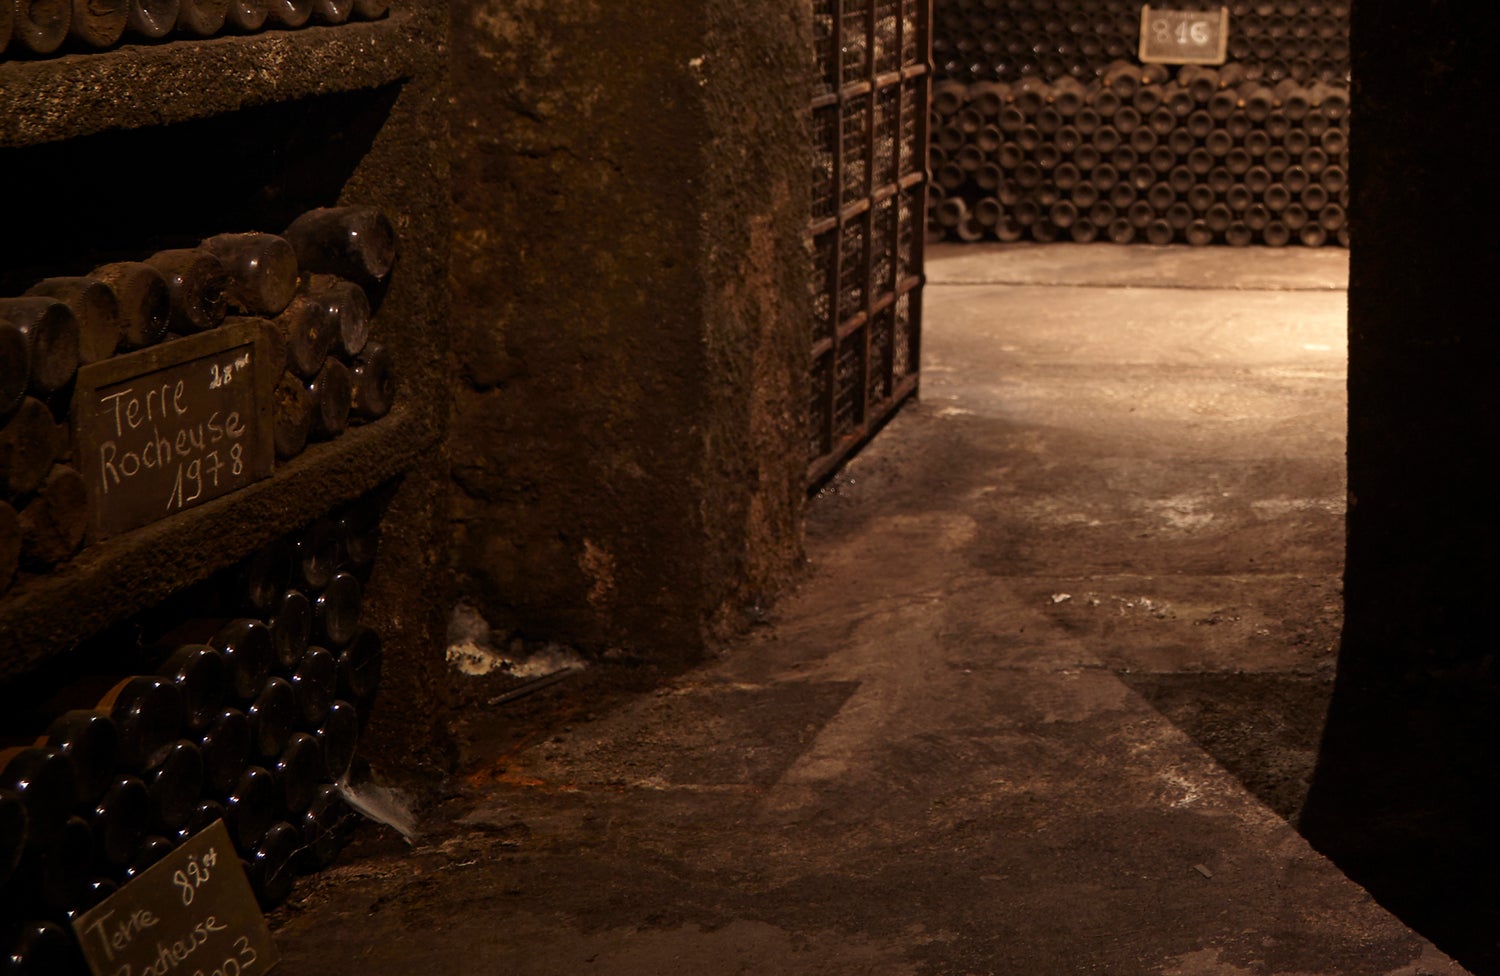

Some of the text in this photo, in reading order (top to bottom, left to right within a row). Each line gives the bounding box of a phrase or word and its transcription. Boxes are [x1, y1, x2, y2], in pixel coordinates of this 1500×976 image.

[101, 379, 188, 438] Terre
[100, 410, 246, 494] Rocheuse
[166, 442, 244, 511] 1978
[84, 908, 161, 961] Terre
